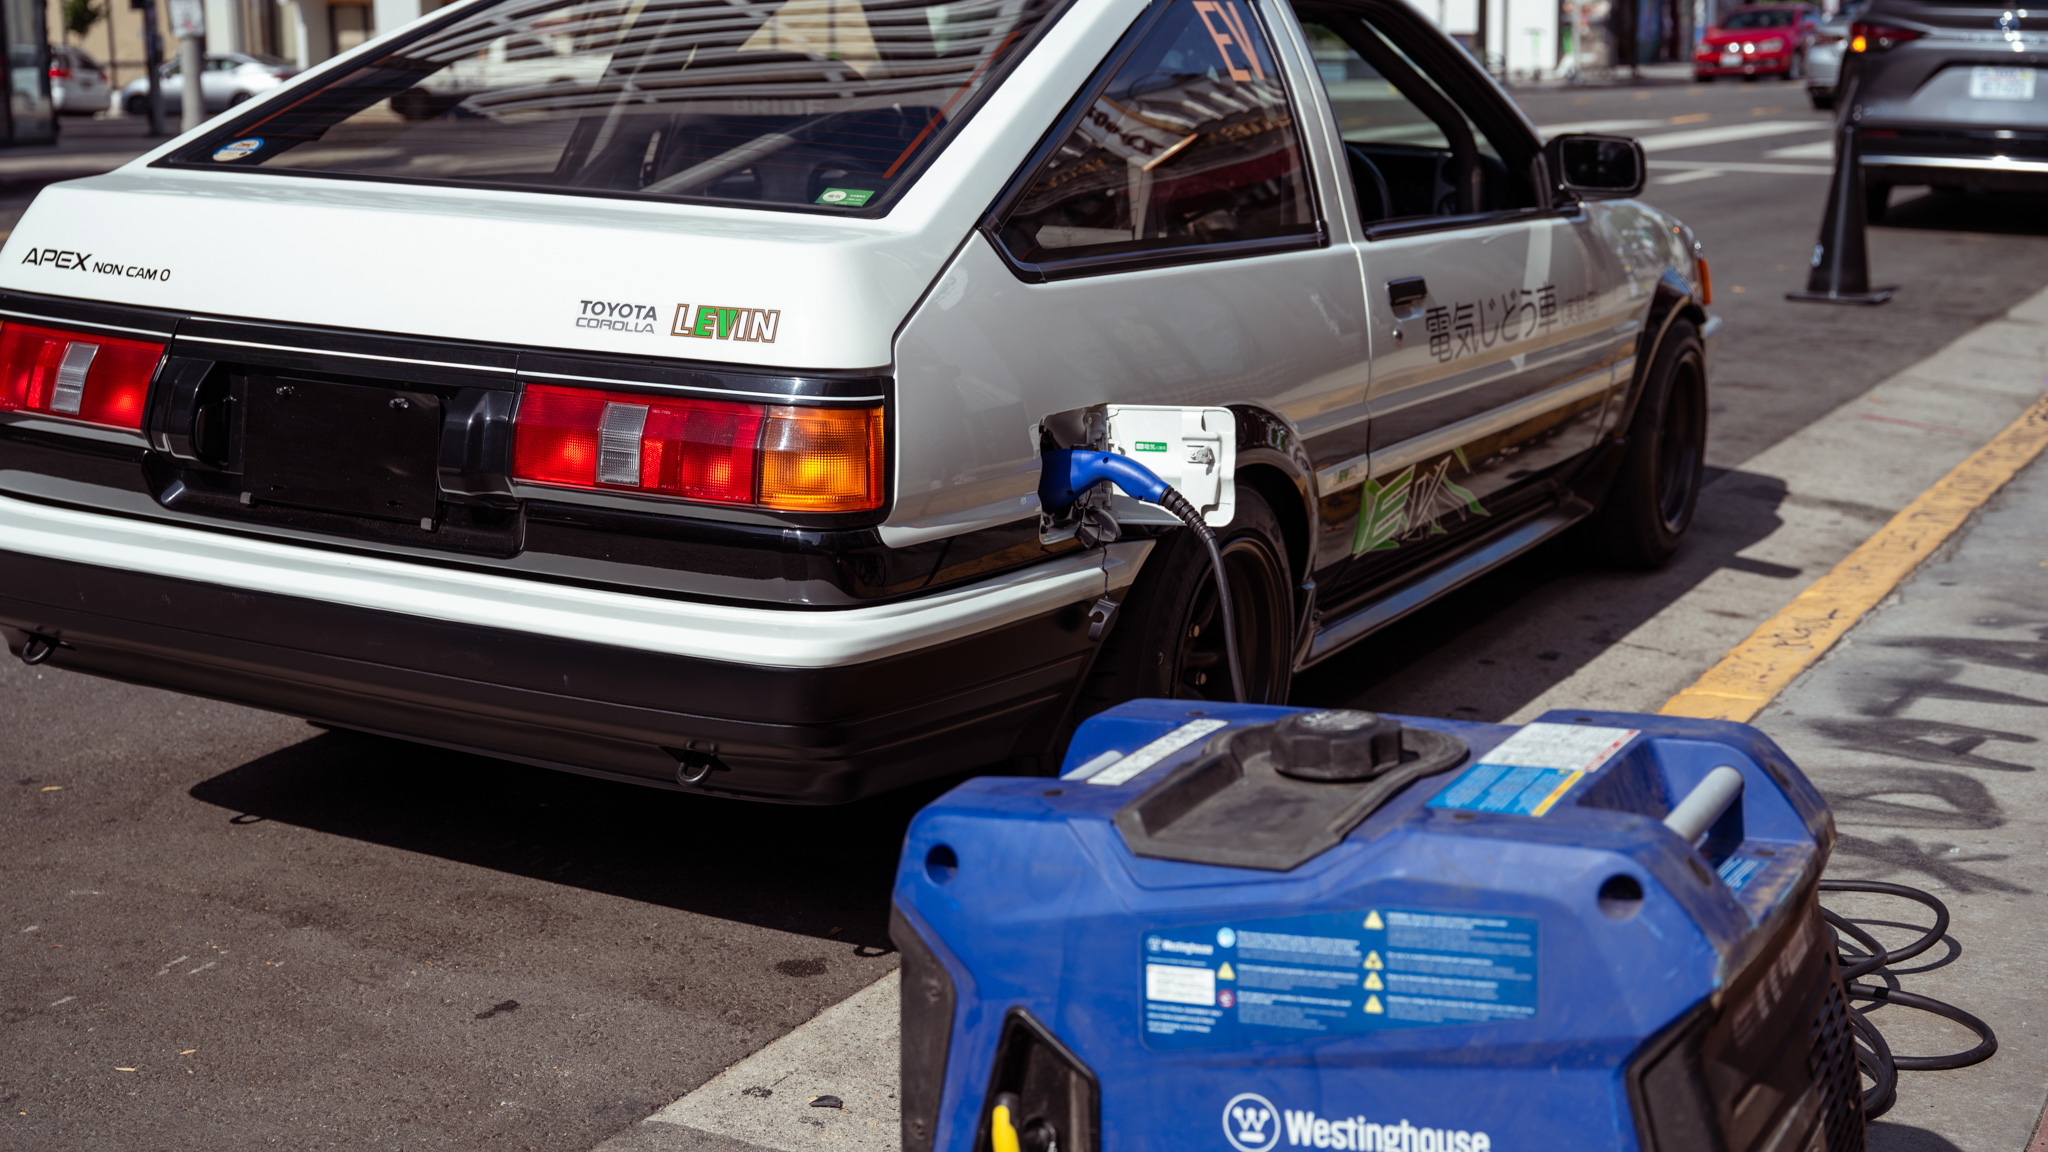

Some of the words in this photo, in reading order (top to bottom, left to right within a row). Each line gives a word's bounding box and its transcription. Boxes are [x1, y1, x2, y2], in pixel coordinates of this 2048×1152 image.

[1193, 1, 1265, 82] EV
[21, 247, 93, 272] APEX
[92, 261, 124, 276] NON
[125, 265, 158, 281] CAM
[575, 316, 655, 334] COROLLA
[580, 299, 658, 321] TOYOTA
[670, 303, 781, 344] LEVIN
[1284, 1109, 1491, 1152] Westinghouse
